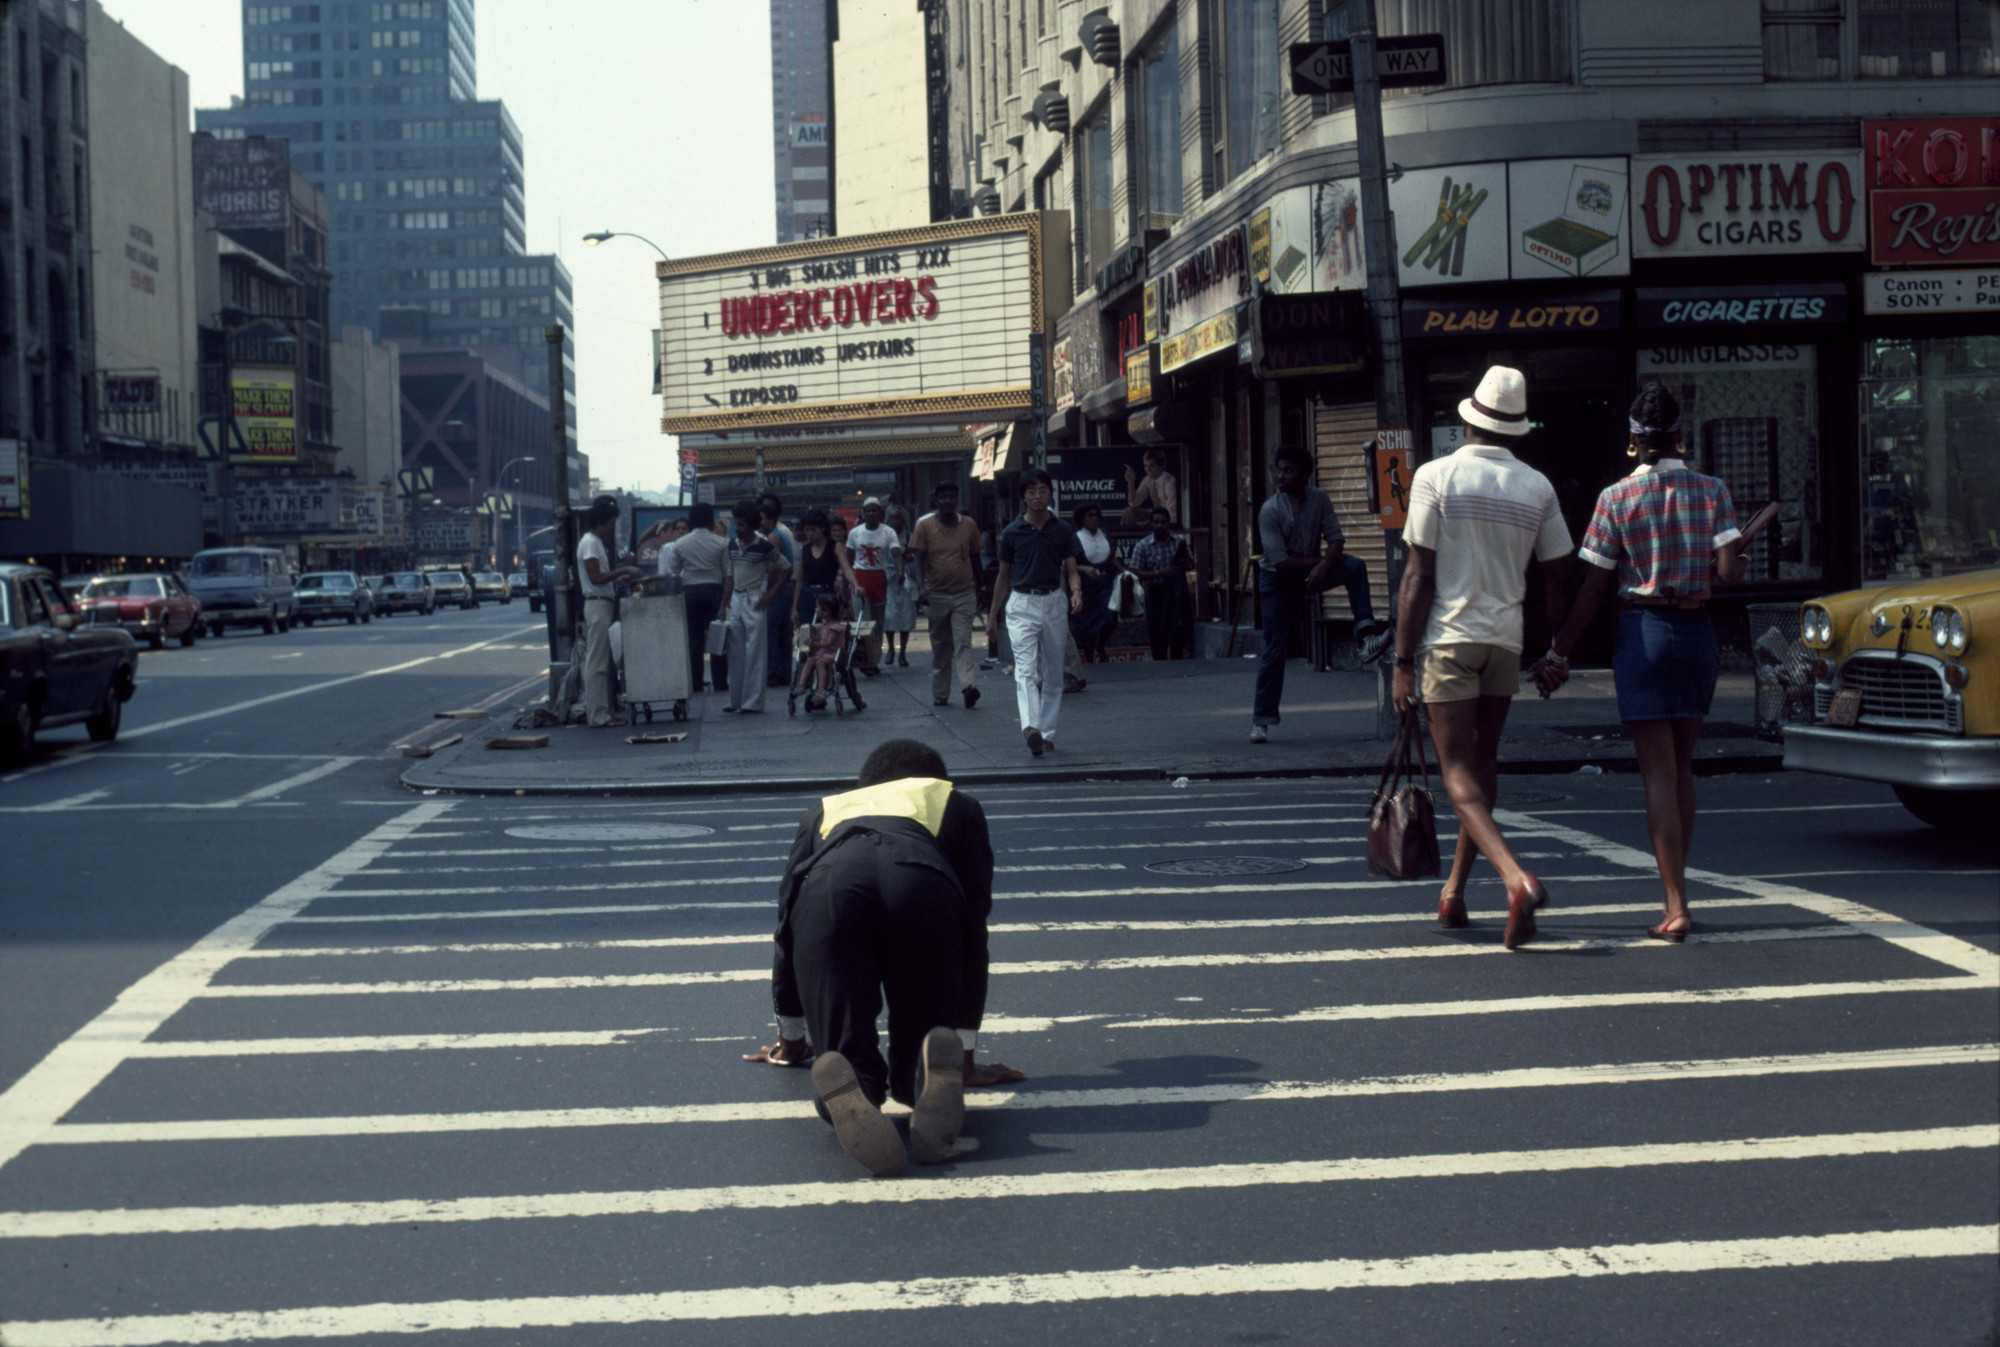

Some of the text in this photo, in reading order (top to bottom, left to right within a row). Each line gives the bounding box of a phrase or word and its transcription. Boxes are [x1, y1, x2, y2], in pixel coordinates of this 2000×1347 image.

[1386, 50, 1431, 72] WAY
[202, 189, 280, 213] MORRIS
[1641, 162, 1856, 246] OPTIMO
[1697, 218, 1803, 245] CIGARS
[1530, 243, 1572, 266] OPTIMO
[766, 268, 792, 289] BIG
[801, 259, 857, 284] SMASH
[864, 253, 901, 276] HITS
[916, 246, 951, 268] XXX
[1883, 278, 1943, 291] Canon
[720, 274, 941, 339] UNDERCOVERS
[1662, 297, 1826, 323] CIGARETTES
[1886, 294, 1945, 307] SONY
[1423, 304, 1600, 332] PLAY LOTTO
[703, 338, 915, 375] 2 DOWNSTAIRS UPSTAIRS
[1650, 345, 1800, 365] SUNGLASSES
[264, 390, 291, 403] THEM
[729, 384, 798, 407] EXPOSED
[1033, 354, 1045, 467] SUBWAY
[1449, 428, 1457, 442] 3
[1060, 479, 1116, 491] VANTAGE
[235, 495, 323, 511] STRYKER
[1060, 493, 1072, 501] THE
[238, 511, 306, 522] WARLORDS
